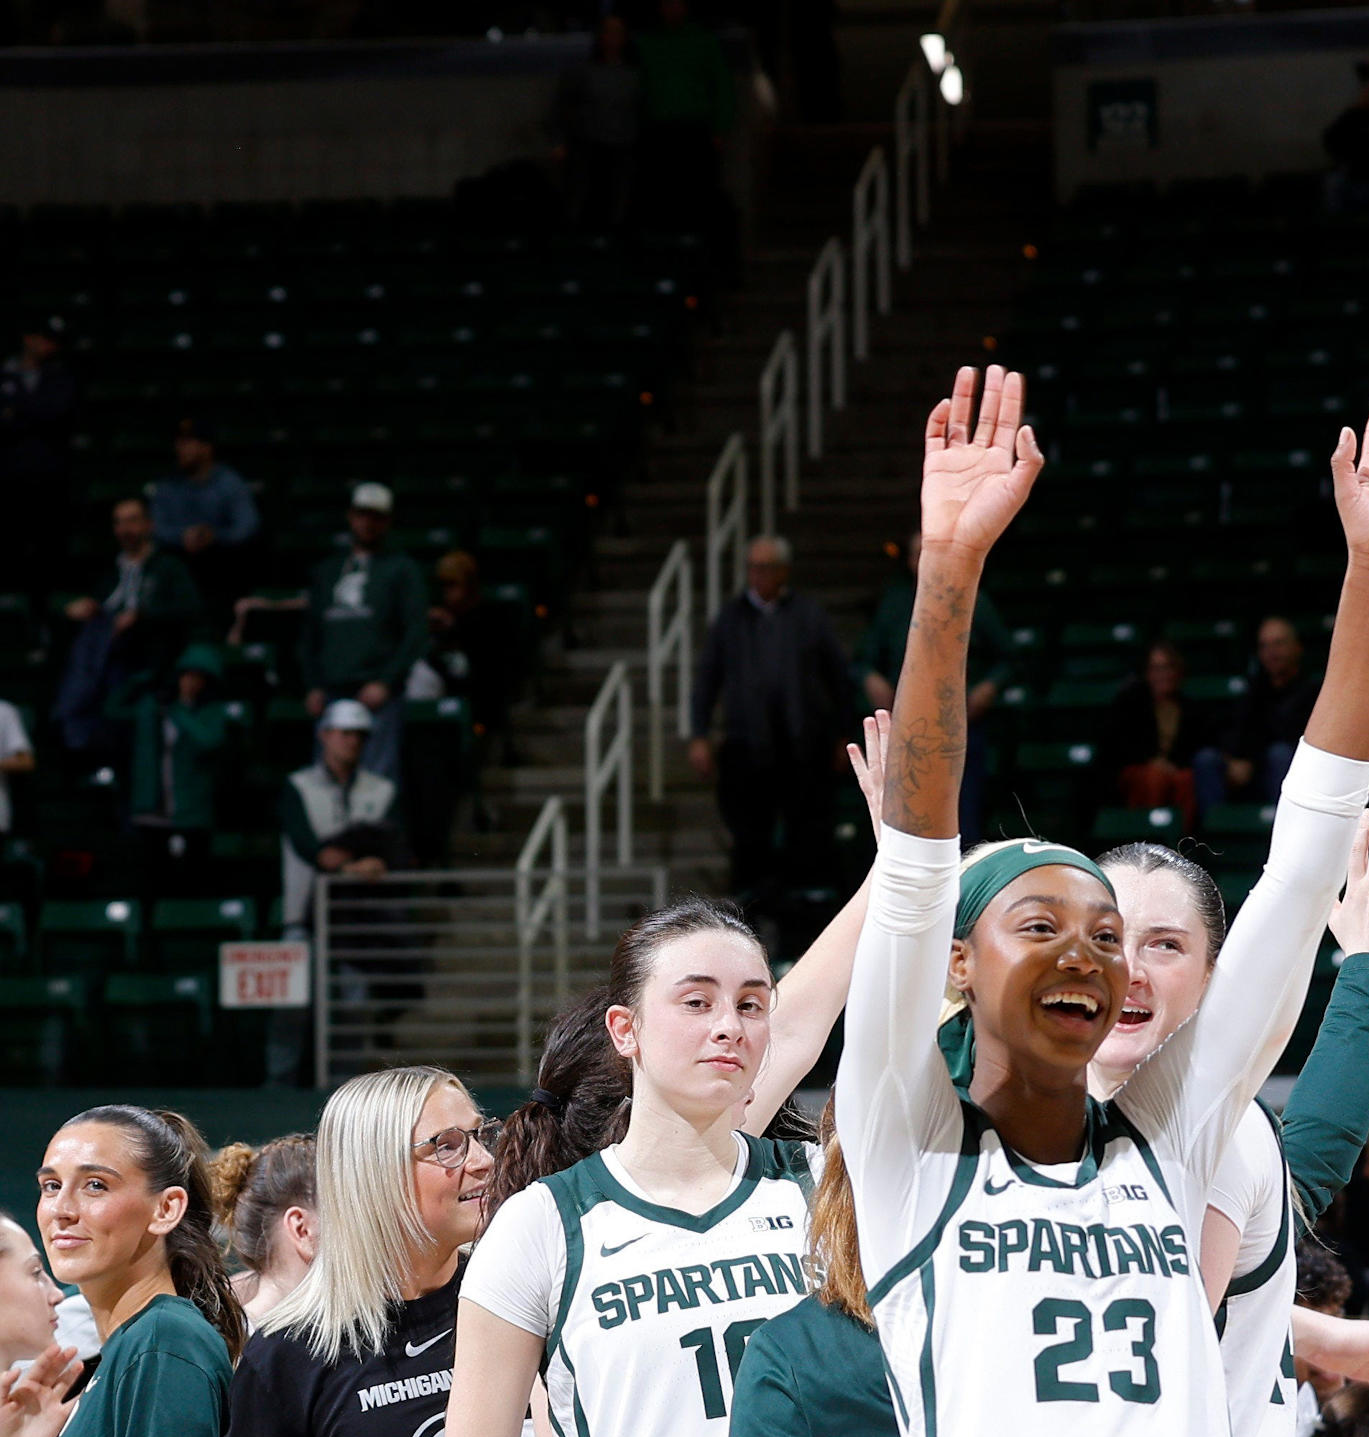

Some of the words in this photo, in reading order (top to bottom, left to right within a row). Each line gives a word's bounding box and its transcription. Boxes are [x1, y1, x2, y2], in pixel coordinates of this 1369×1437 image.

[237, 969, 289, 999] EXIT
[749, 1215, 794, 1232] BIG
[959, 1218, 1190, 1279] SPARTANS
[1032, 1297, 1162, 1405] 23
